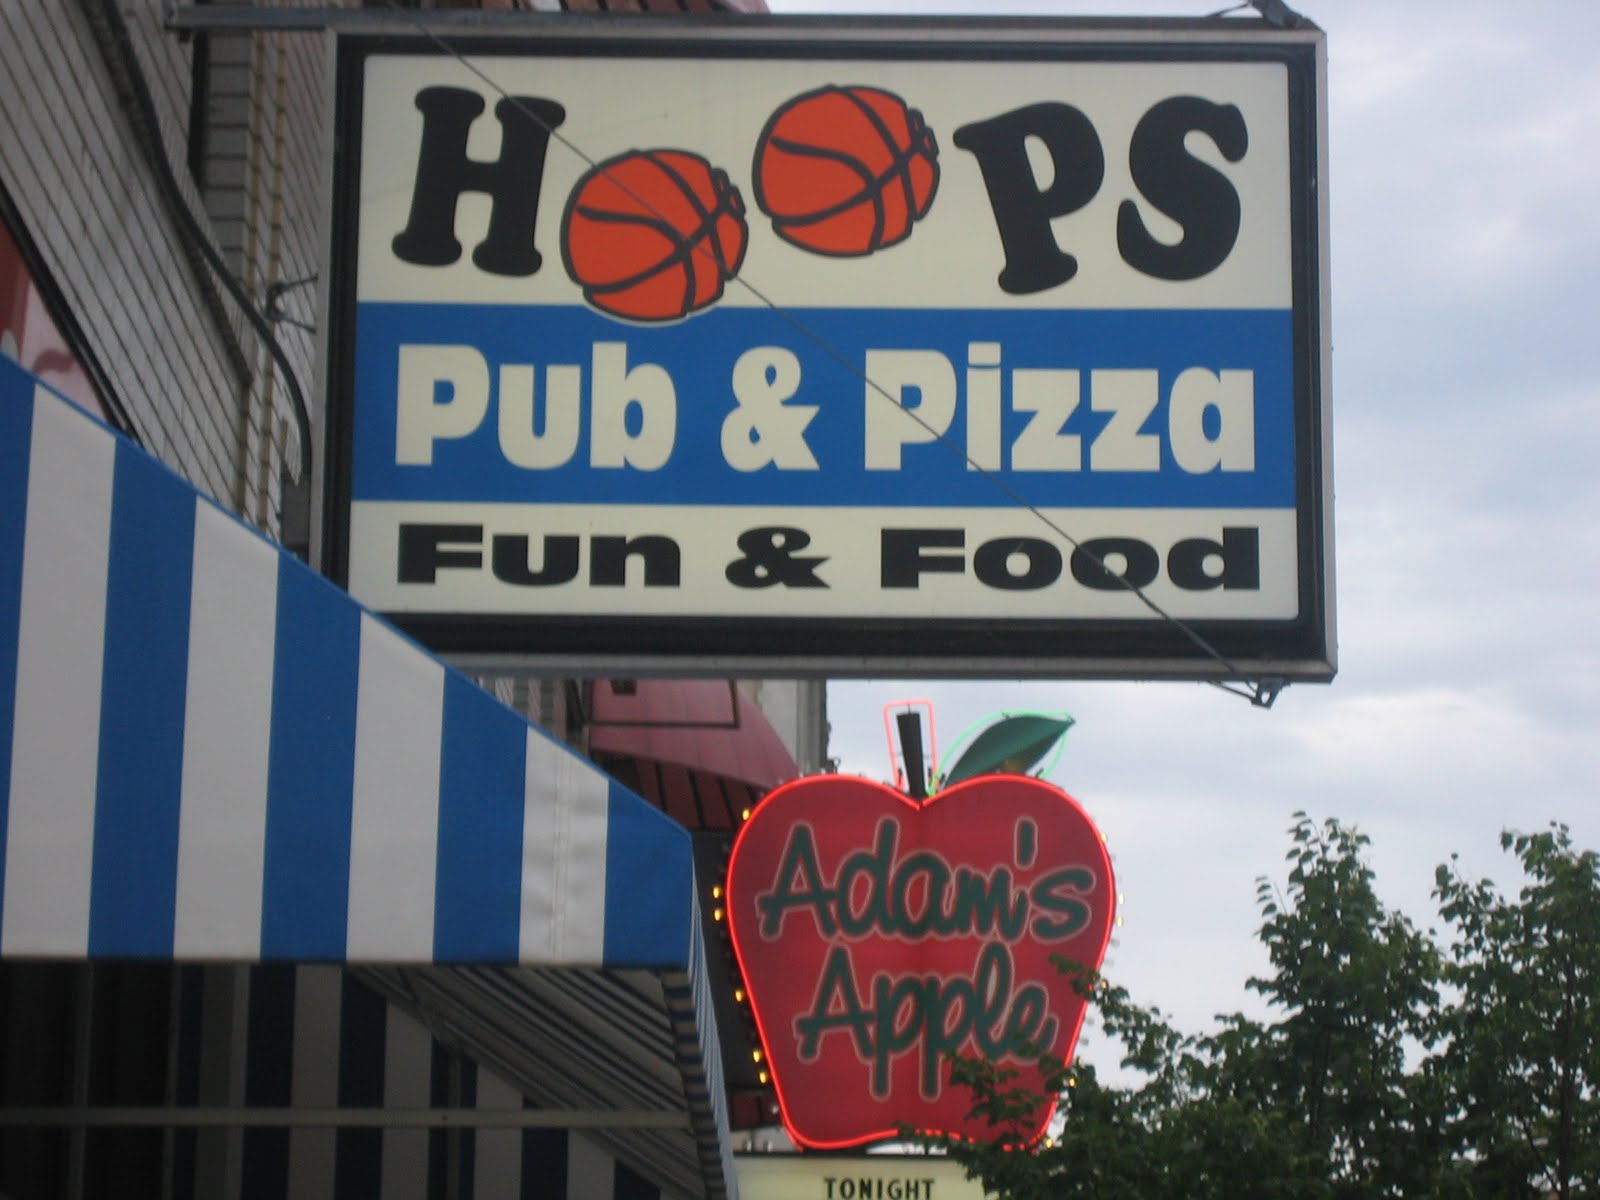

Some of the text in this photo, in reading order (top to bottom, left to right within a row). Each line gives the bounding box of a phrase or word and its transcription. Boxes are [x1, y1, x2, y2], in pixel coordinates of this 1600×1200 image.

[394, 340, 1256, 475] Pub & Pizza
[398, 523, 1260, 592] Fun & Food
[756, 815, 1096, 941] Adam's
[793, 940, 1060, 1101] Apple
[823, 1176, 936, 1200] TONIGHT
